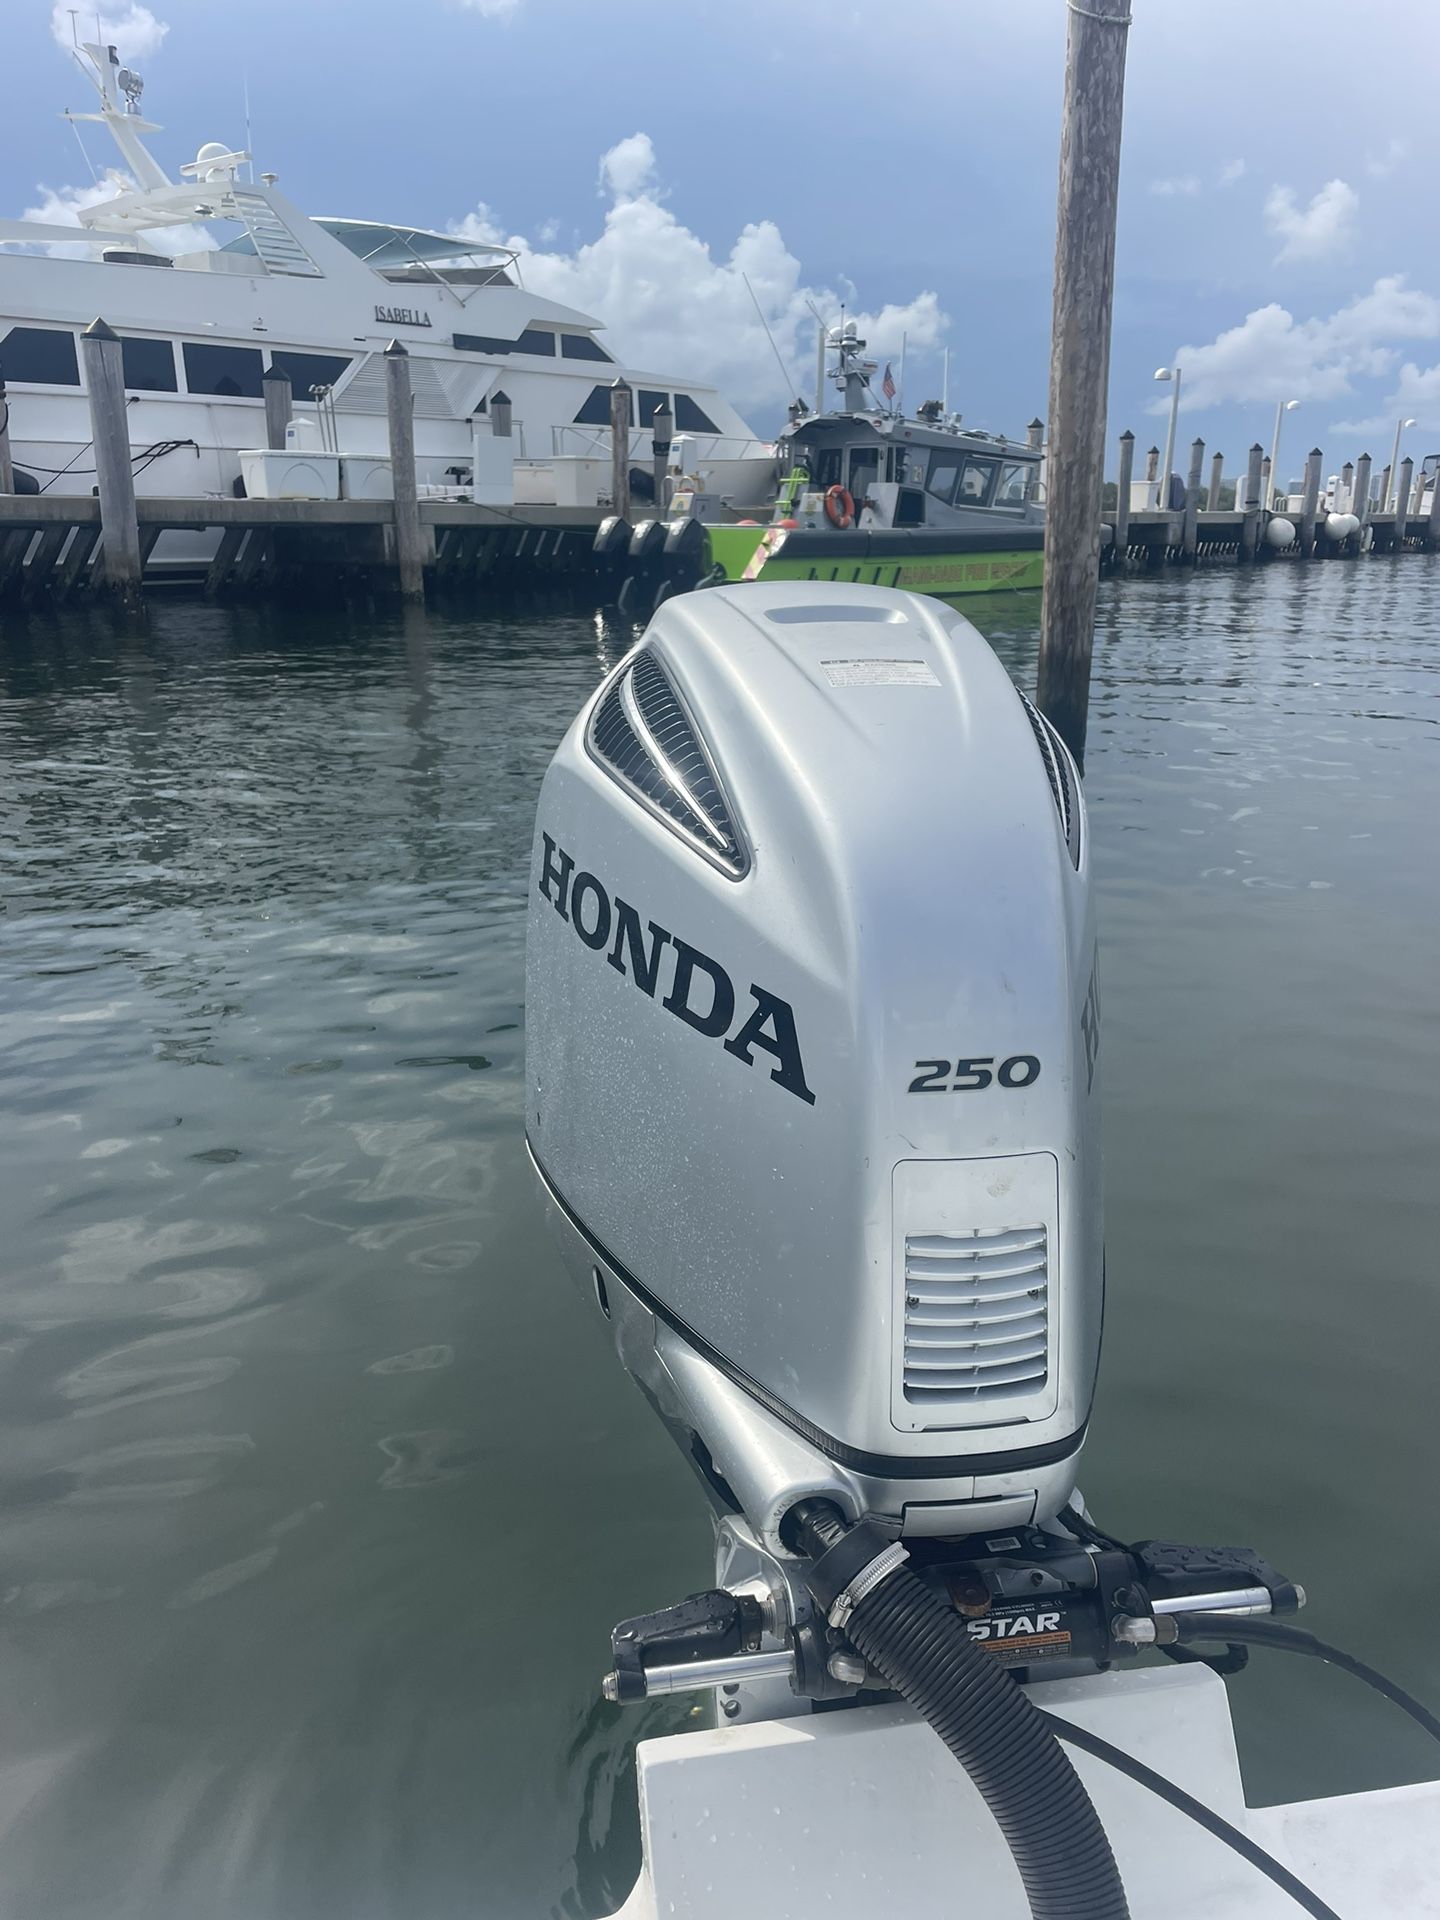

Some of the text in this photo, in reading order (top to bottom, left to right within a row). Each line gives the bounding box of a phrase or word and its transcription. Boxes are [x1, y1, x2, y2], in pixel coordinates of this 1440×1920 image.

[375, 305, 432, 327] ISABELLA
[539, 831, 816, 1106] HONDA
[908, 1055, 1041, 1093] 250
